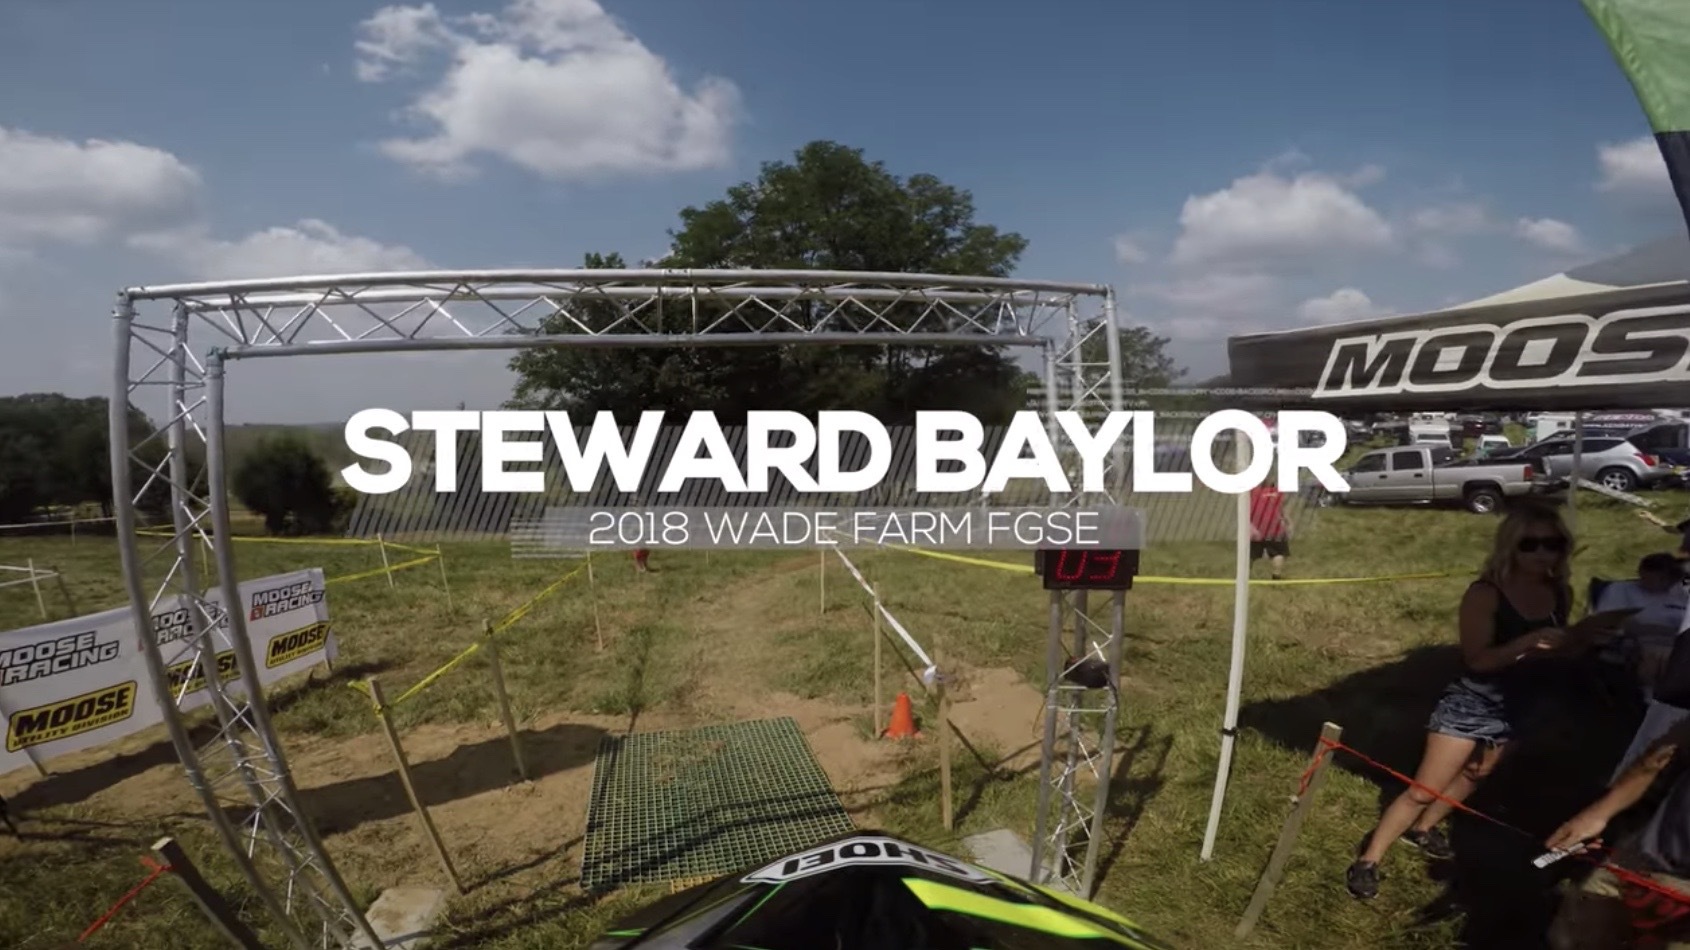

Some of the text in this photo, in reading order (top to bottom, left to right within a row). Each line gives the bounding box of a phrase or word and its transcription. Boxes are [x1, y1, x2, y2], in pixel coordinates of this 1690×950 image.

[1311, 303, 1690, 398] MOOS
[252, 580, 312, 608] MOOSE
[263, 590, 325, 618] RACING
[271, 624, 326, 657] MOOSE
[1, 640, 120, 687] RACING
[15, 686, 131, 738] MOOSE
[781, 841, 970, 877] SHOEI
